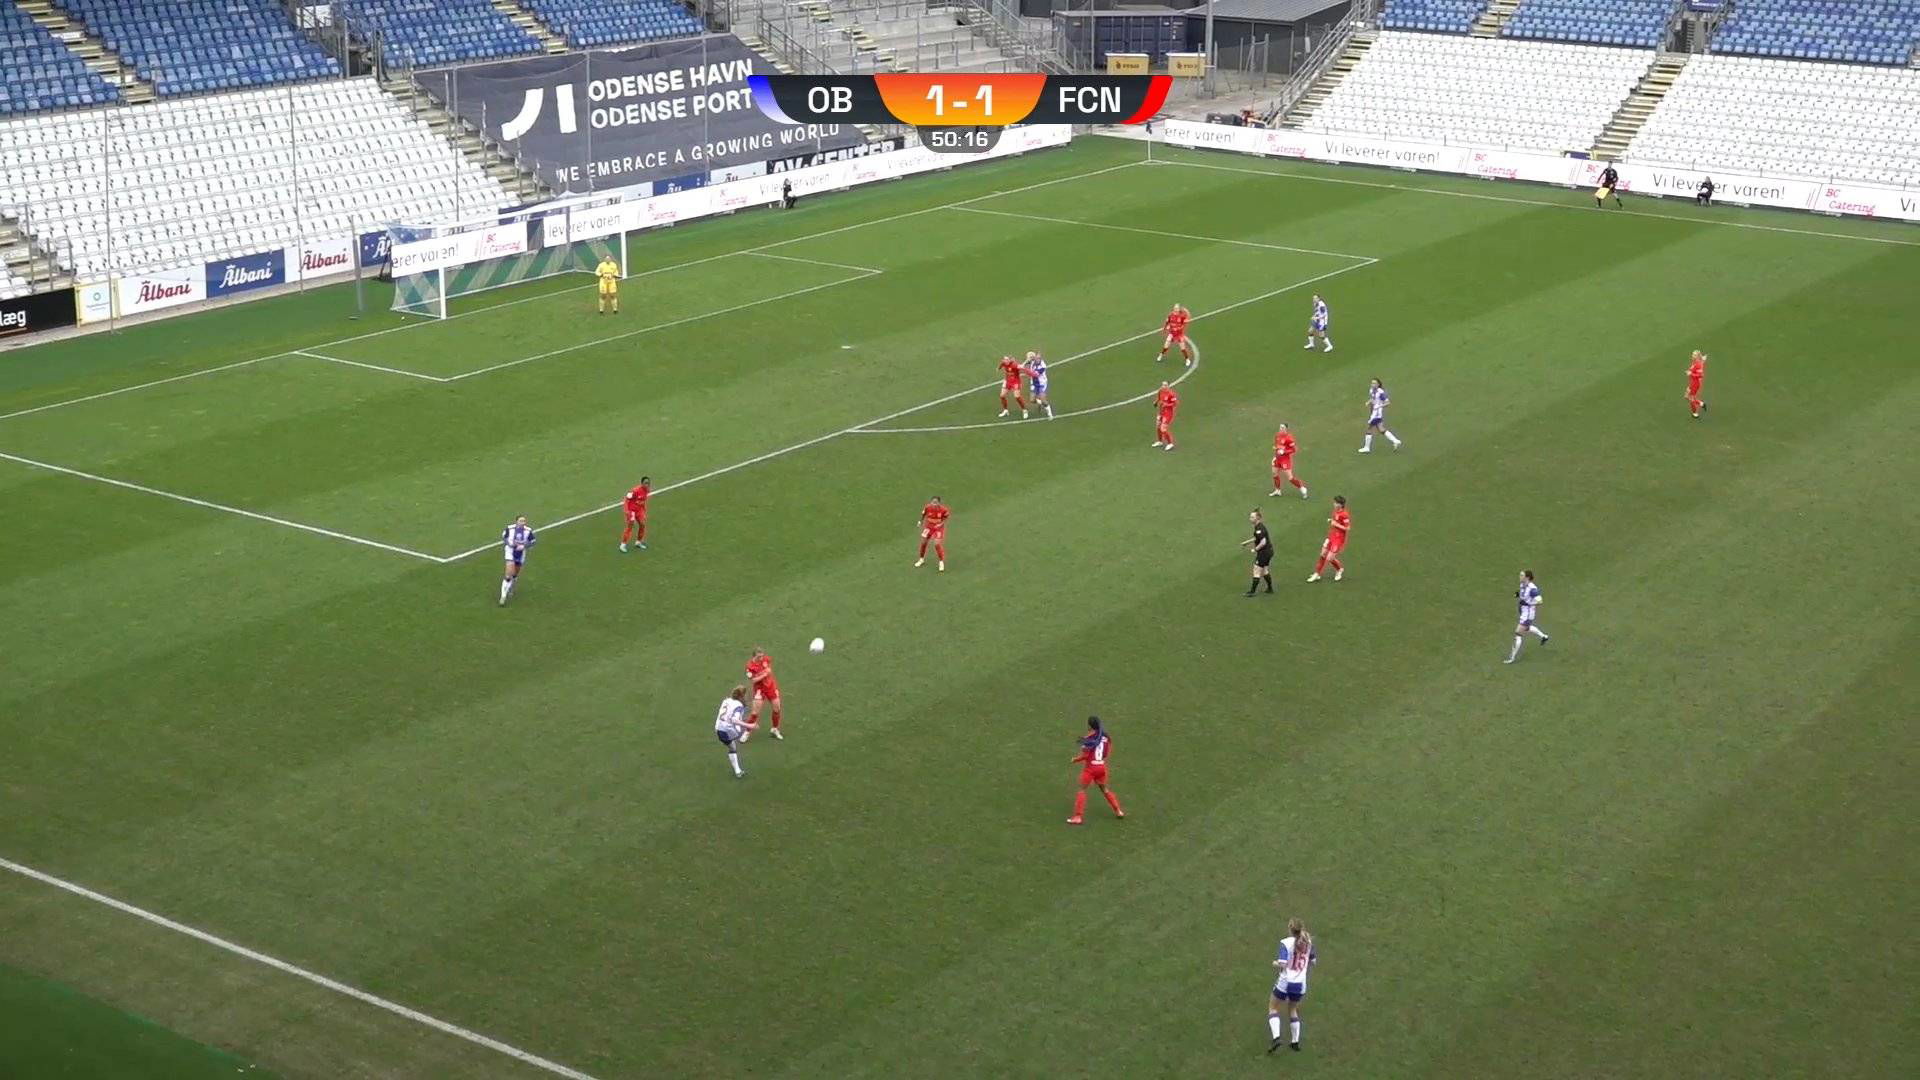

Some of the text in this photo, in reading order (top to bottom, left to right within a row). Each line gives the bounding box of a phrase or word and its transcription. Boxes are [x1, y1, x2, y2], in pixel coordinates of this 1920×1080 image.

[588, 58, 752, 101] ODENSE HAVN
[591, 88, 752, 129] ODENSE PORT
[557, 123, 840, 183] WE EMBRACE A GROWING WORLD
[1733, 184, 1785, 199] varen!
[1826, 188, 1841, 198] BC
[1829, 200, 1876, 217] Catering
[219, 261, 273, 288] Albani
[135, 278, 192, 304] Albani
